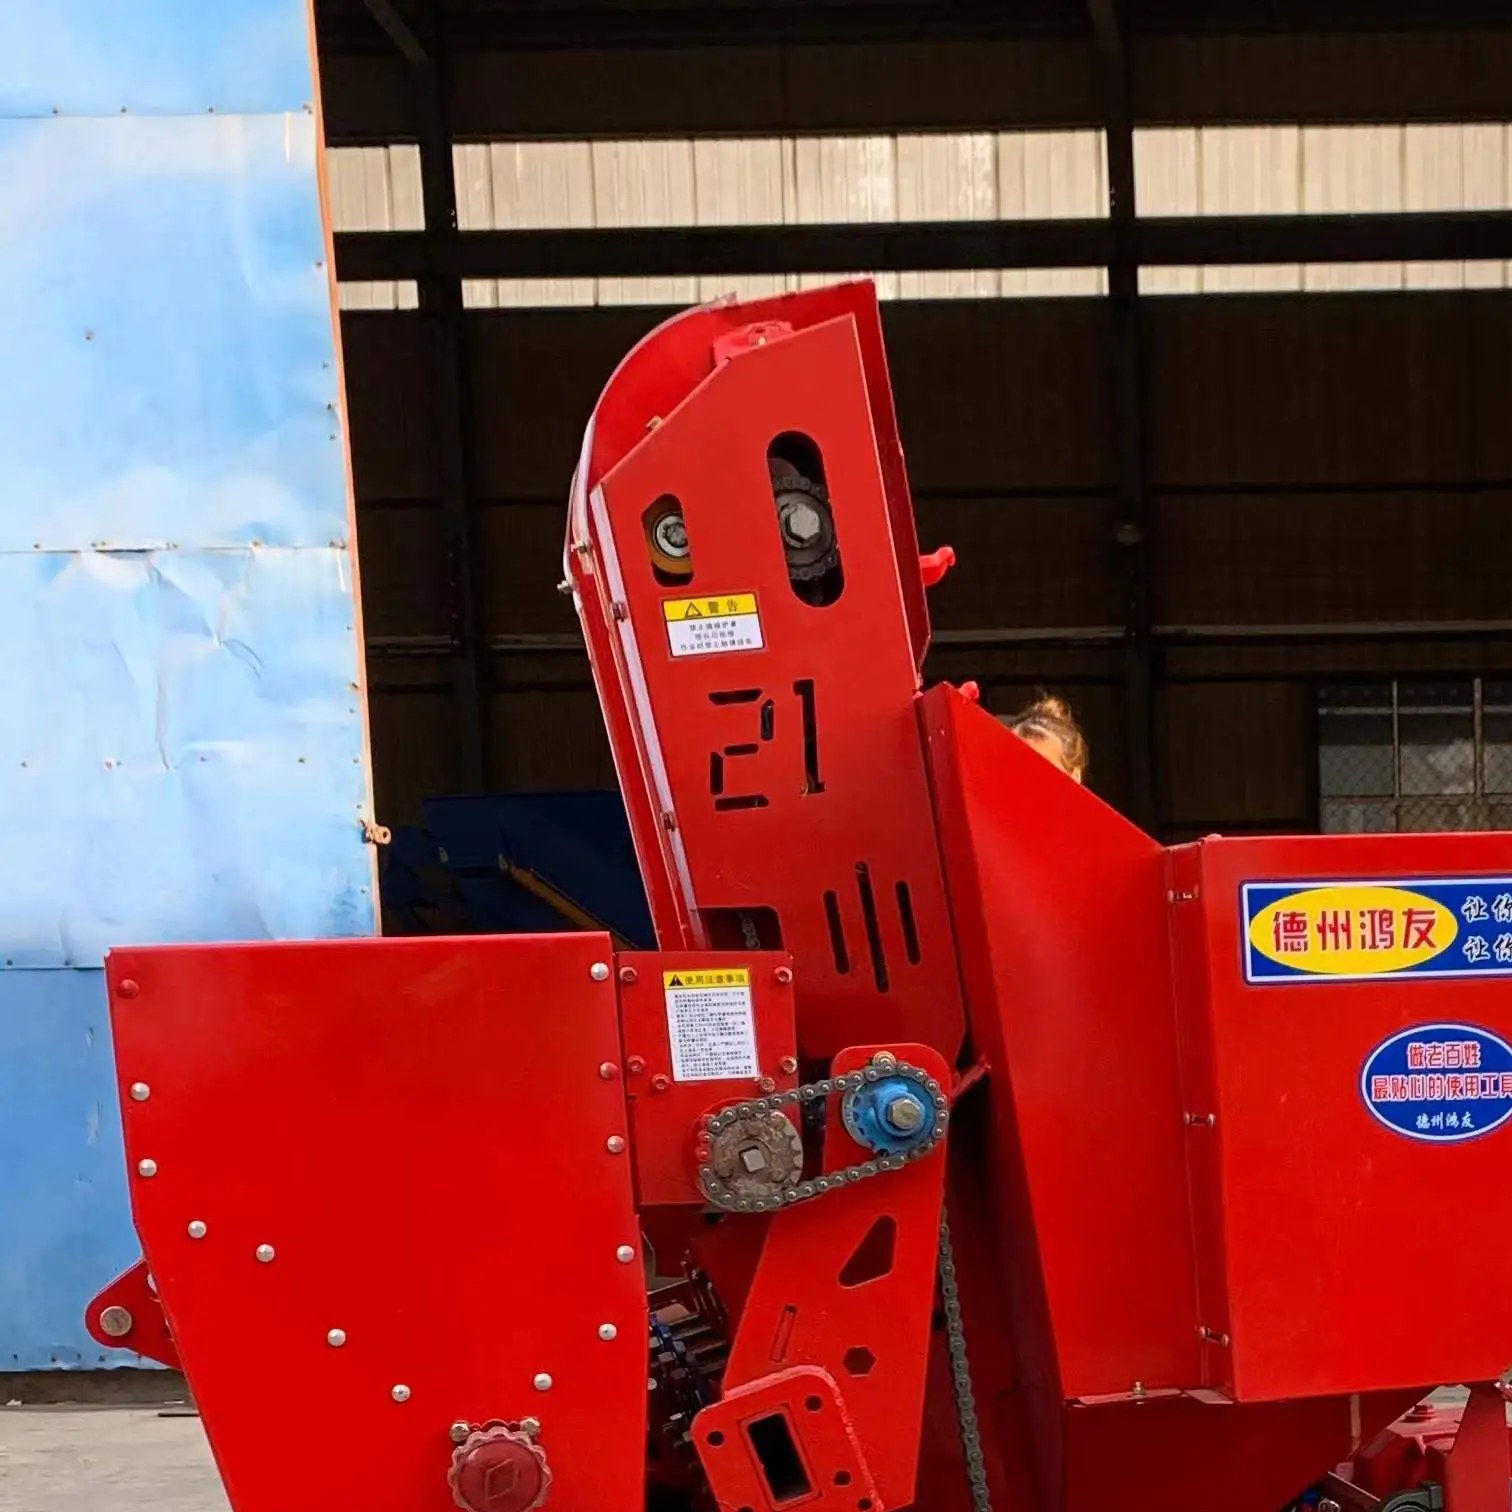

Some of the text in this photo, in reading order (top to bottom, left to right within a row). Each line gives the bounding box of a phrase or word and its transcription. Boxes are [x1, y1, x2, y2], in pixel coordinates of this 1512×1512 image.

[707, 599, 739, 614] 警告
[1273, 908, 1437, 953] 德州鸿友
[1407, 1041, 1482, 1069] 做老百姓
[1415, 1111, 1475, 1130] 德州鸿友
